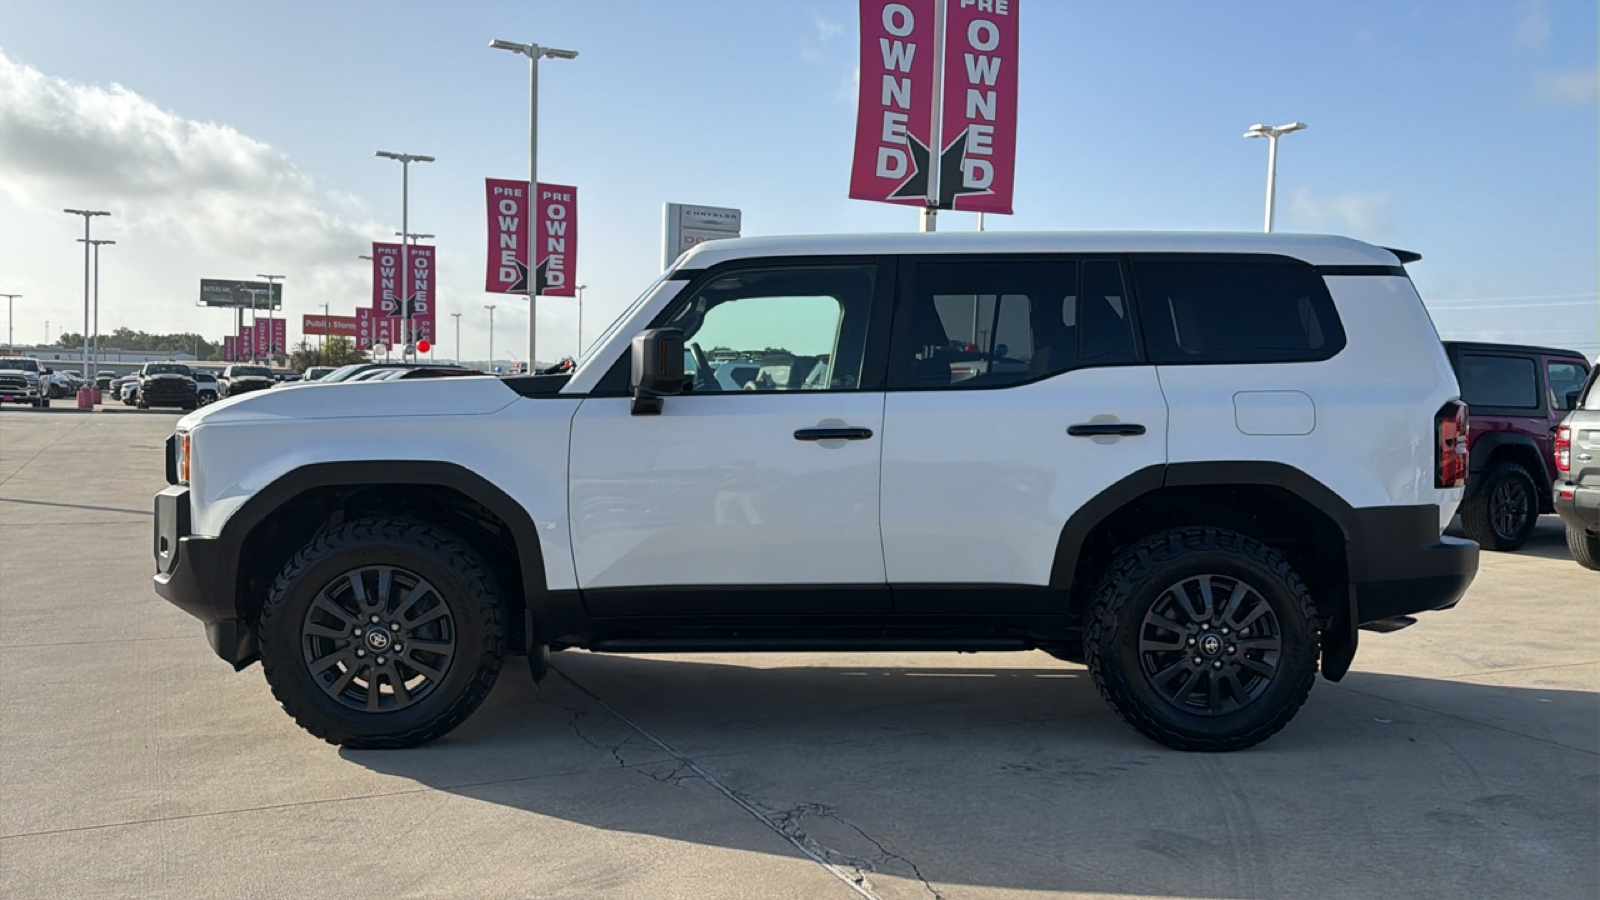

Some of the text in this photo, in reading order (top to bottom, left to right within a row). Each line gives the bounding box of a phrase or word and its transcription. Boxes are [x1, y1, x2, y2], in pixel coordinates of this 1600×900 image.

[960, 0, 1009, 16] PRE
[875, 3, 917, 180] OWNED
[963, 19, 1002, 190] OWNED
[493, 187, 523, 197] PRE
[543, 191, 571, 202] PRE
[685, 209, 737, 219] CHRYSLER
[378, 247, 398, 255] PRE
[498, 199, 520, 283] OWNED
[545, 204, 567, 286] OWNED
[380, 255, 396, 311] OWNED
[413, 258, 429, 312] OWNED
[360, 310, 368, 346] Jeep
[380, 321, 389, 344] RAM
